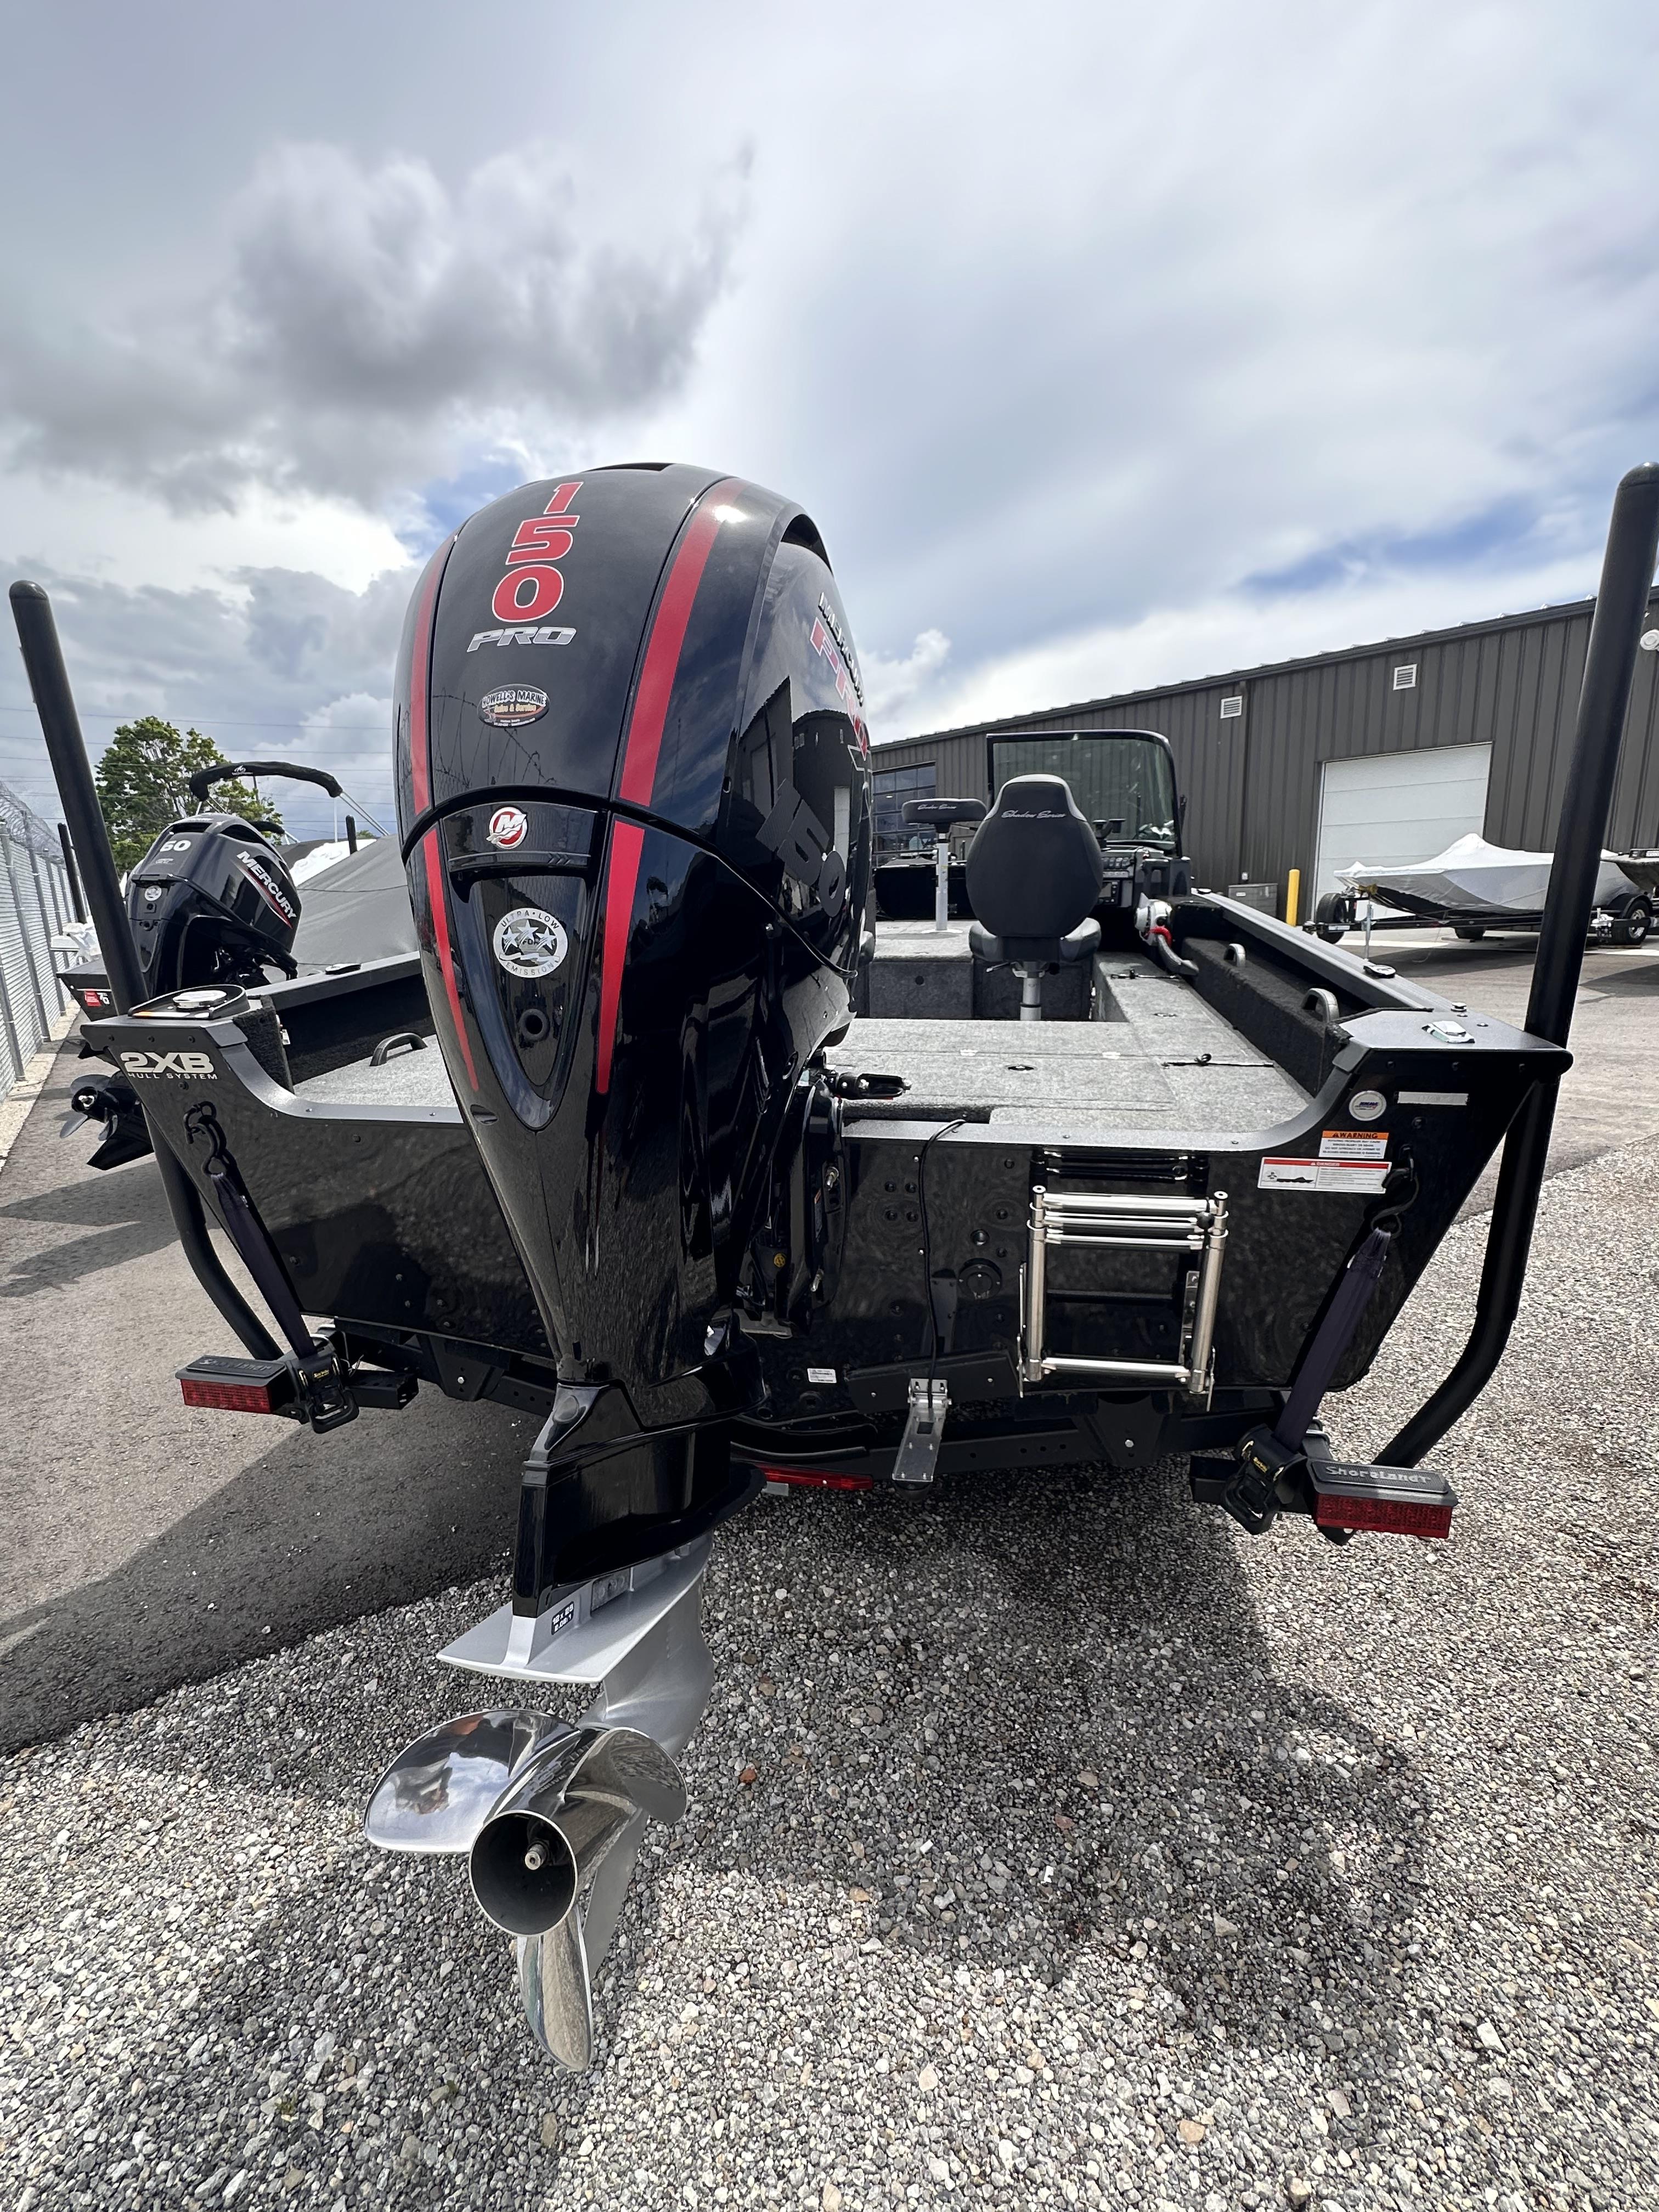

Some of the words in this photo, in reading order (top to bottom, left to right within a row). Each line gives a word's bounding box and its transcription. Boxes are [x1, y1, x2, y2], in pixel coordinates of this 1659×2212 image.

[492, 482, 584, 623] 150
[466, 627, 577, 653] PRO
[516, 690, 547, 707] MARINE
[1001, 810, 1037, 818] Shadow
[160, 839, 191, 853] 60
[755, 778, 847, 918] 150
[236, 851, 296, 918] MERCURY
[538, 912, 560, 929] LOW
[120, 1052, 215, 1074] 2XB
